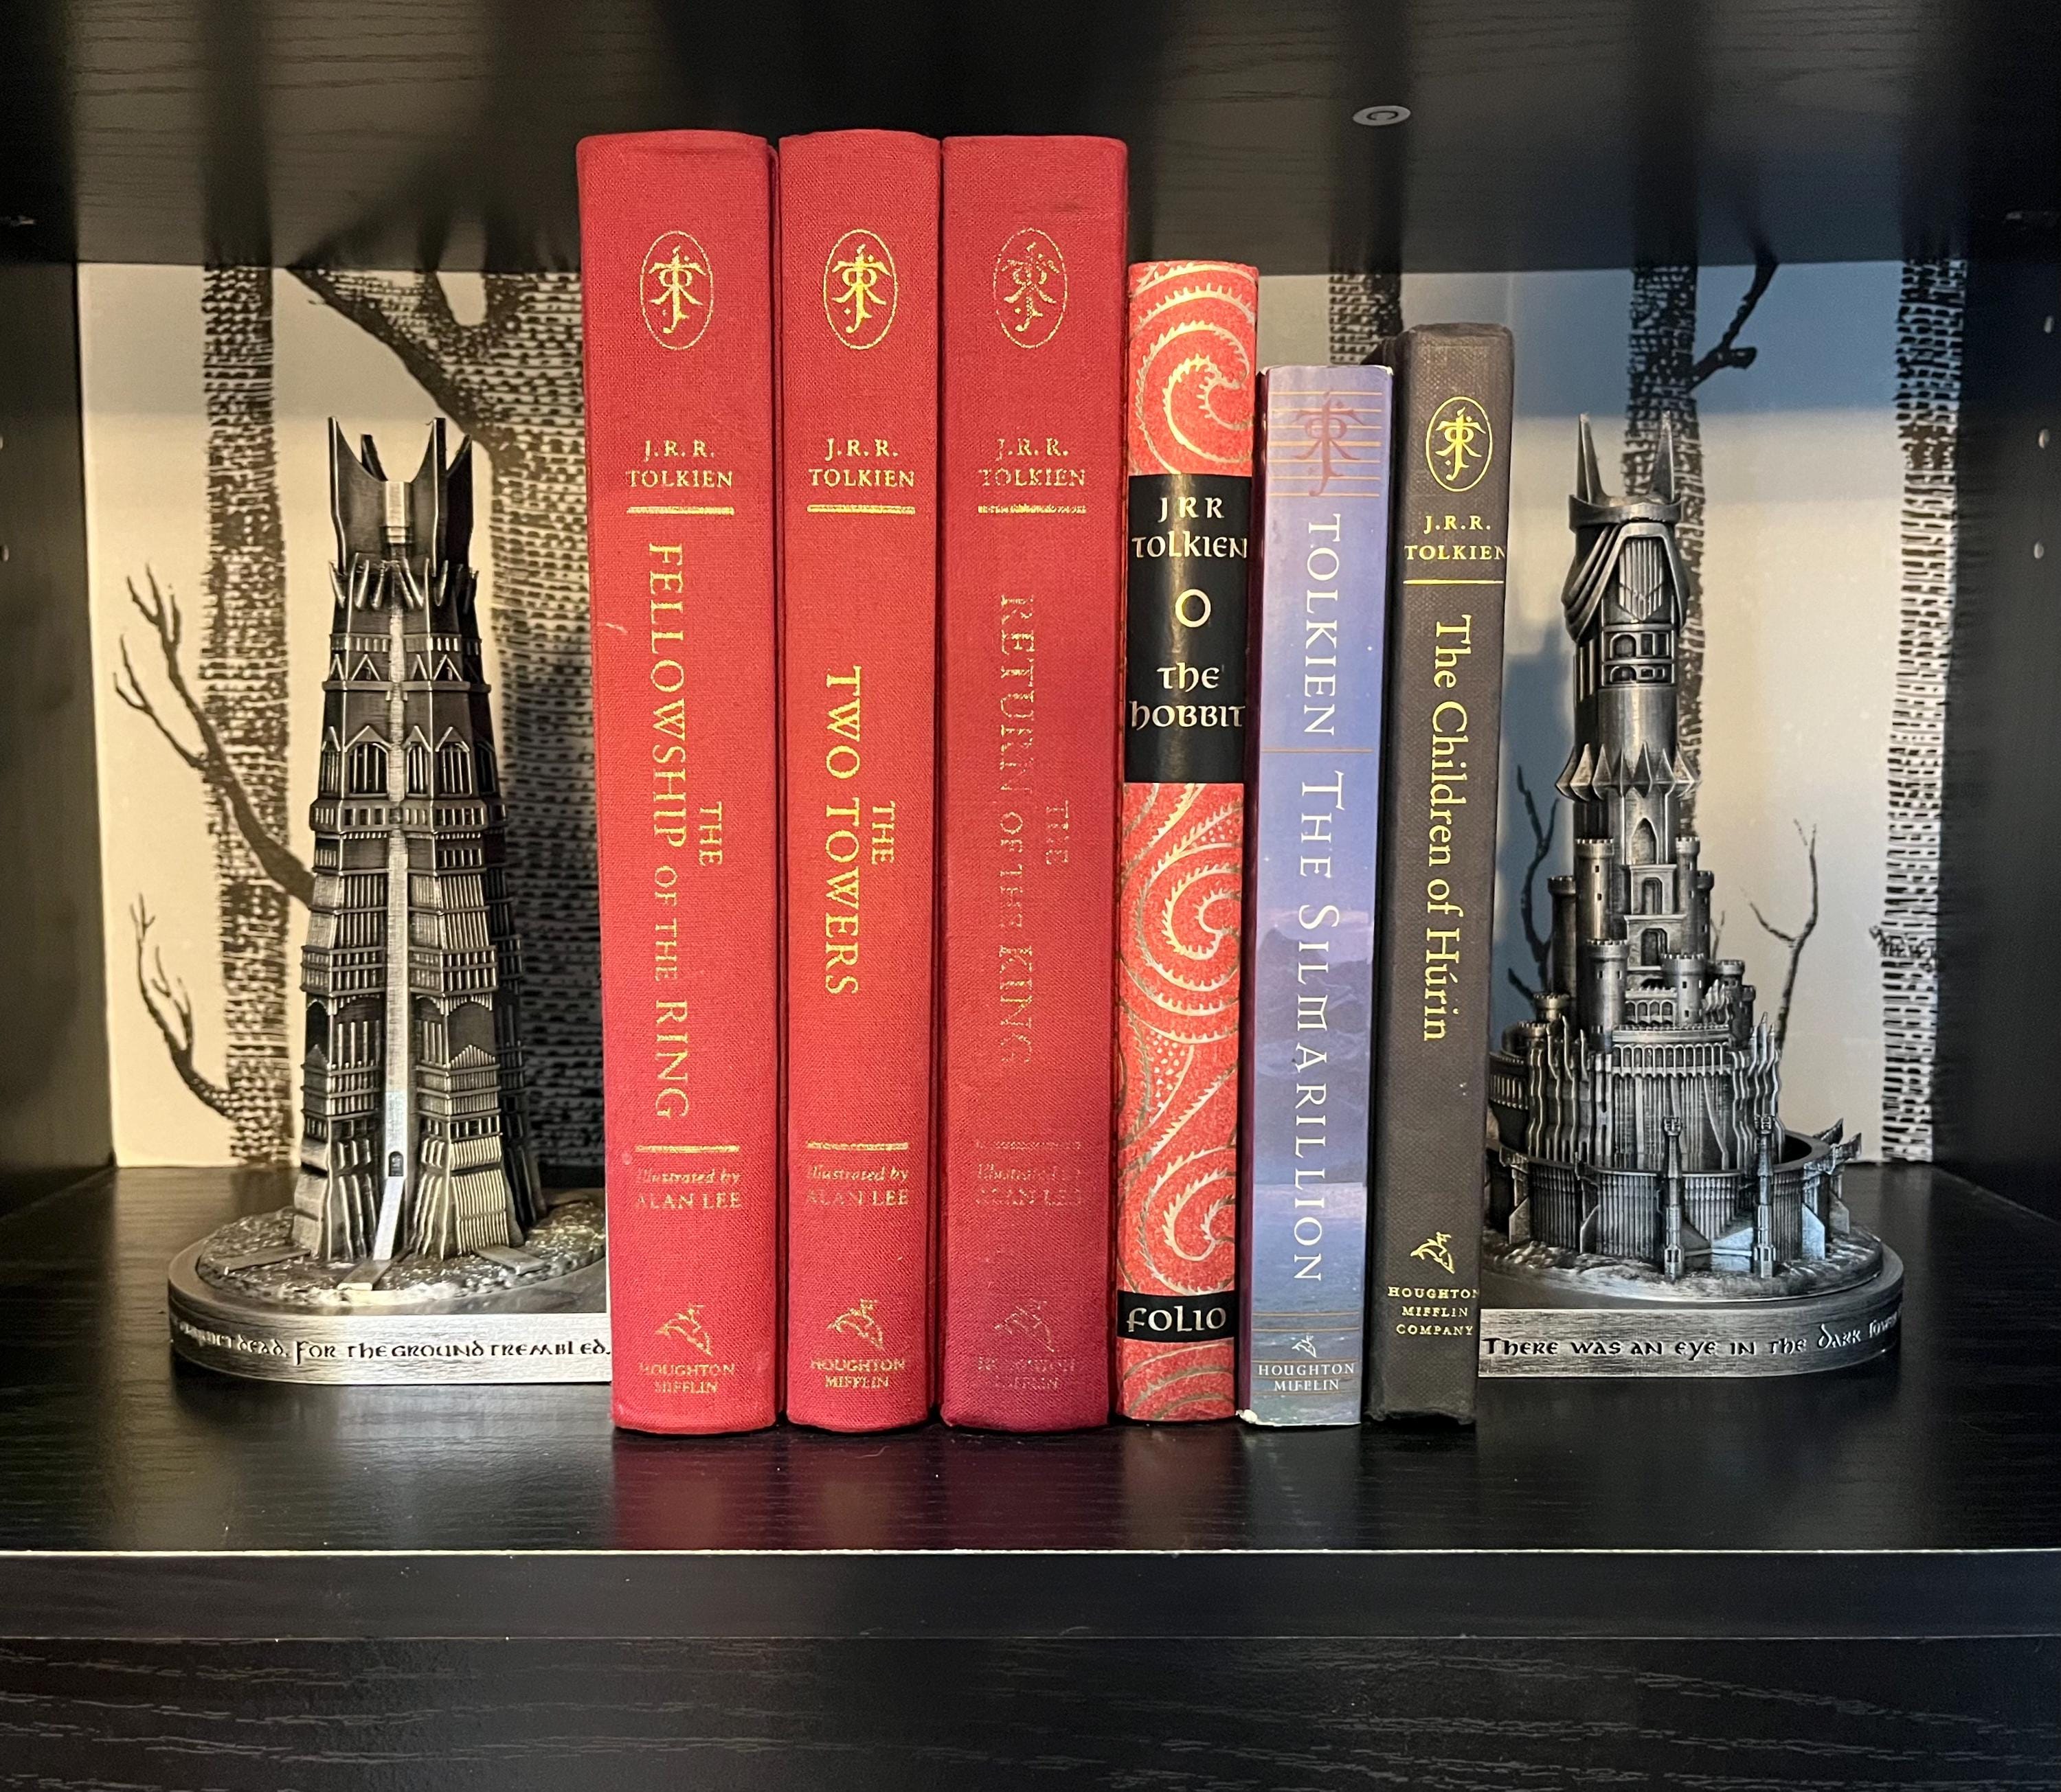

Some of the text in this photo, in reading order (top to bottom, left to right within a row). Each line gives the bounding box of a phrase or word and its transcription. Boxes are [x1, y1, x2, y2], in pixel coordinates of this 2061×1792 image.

[627, 470, 733, 488] TOLKIEN
[807, 469, 914, 488] TOLKIEN
[979, 469, 1085, 486] TOLKIEN
[1131, 531, 1248, 558] TOLKIEN
[1404, 545, 1506, 560] TOLKIEN
[648, 543, 689, 1119] FELLOWSHIP OF THE RING
[698, 802, 723, 867] THE
[824, 665, 862, 995] TWO TOWERS
[871, 801, 895, 865] THE
[1422, 614, 1473, 1042] The Children of Húrin
[1294, 513, 1345, 1282] TOLKIEN THE SILMARILLION
[720, 1170, 741, 1186] by
[890, 1166, 909, 1182] by
[702, 1192, 742, 1208] LEE
[872, 1189, 908, 1205] LEE
[1388, 1286, 1480, 1300] HOUGHTON
[1127, 1307, 1227, 1332] FOLIO
[1402, 1306, 1468, 1318] MIFFLIN
[1396, 1325, 1474, 1337] COMPANY
[1259, 1363, 1355, 1376] HOUGHTON
[1274, 1379, 1340, 1392] MIFFLIN
